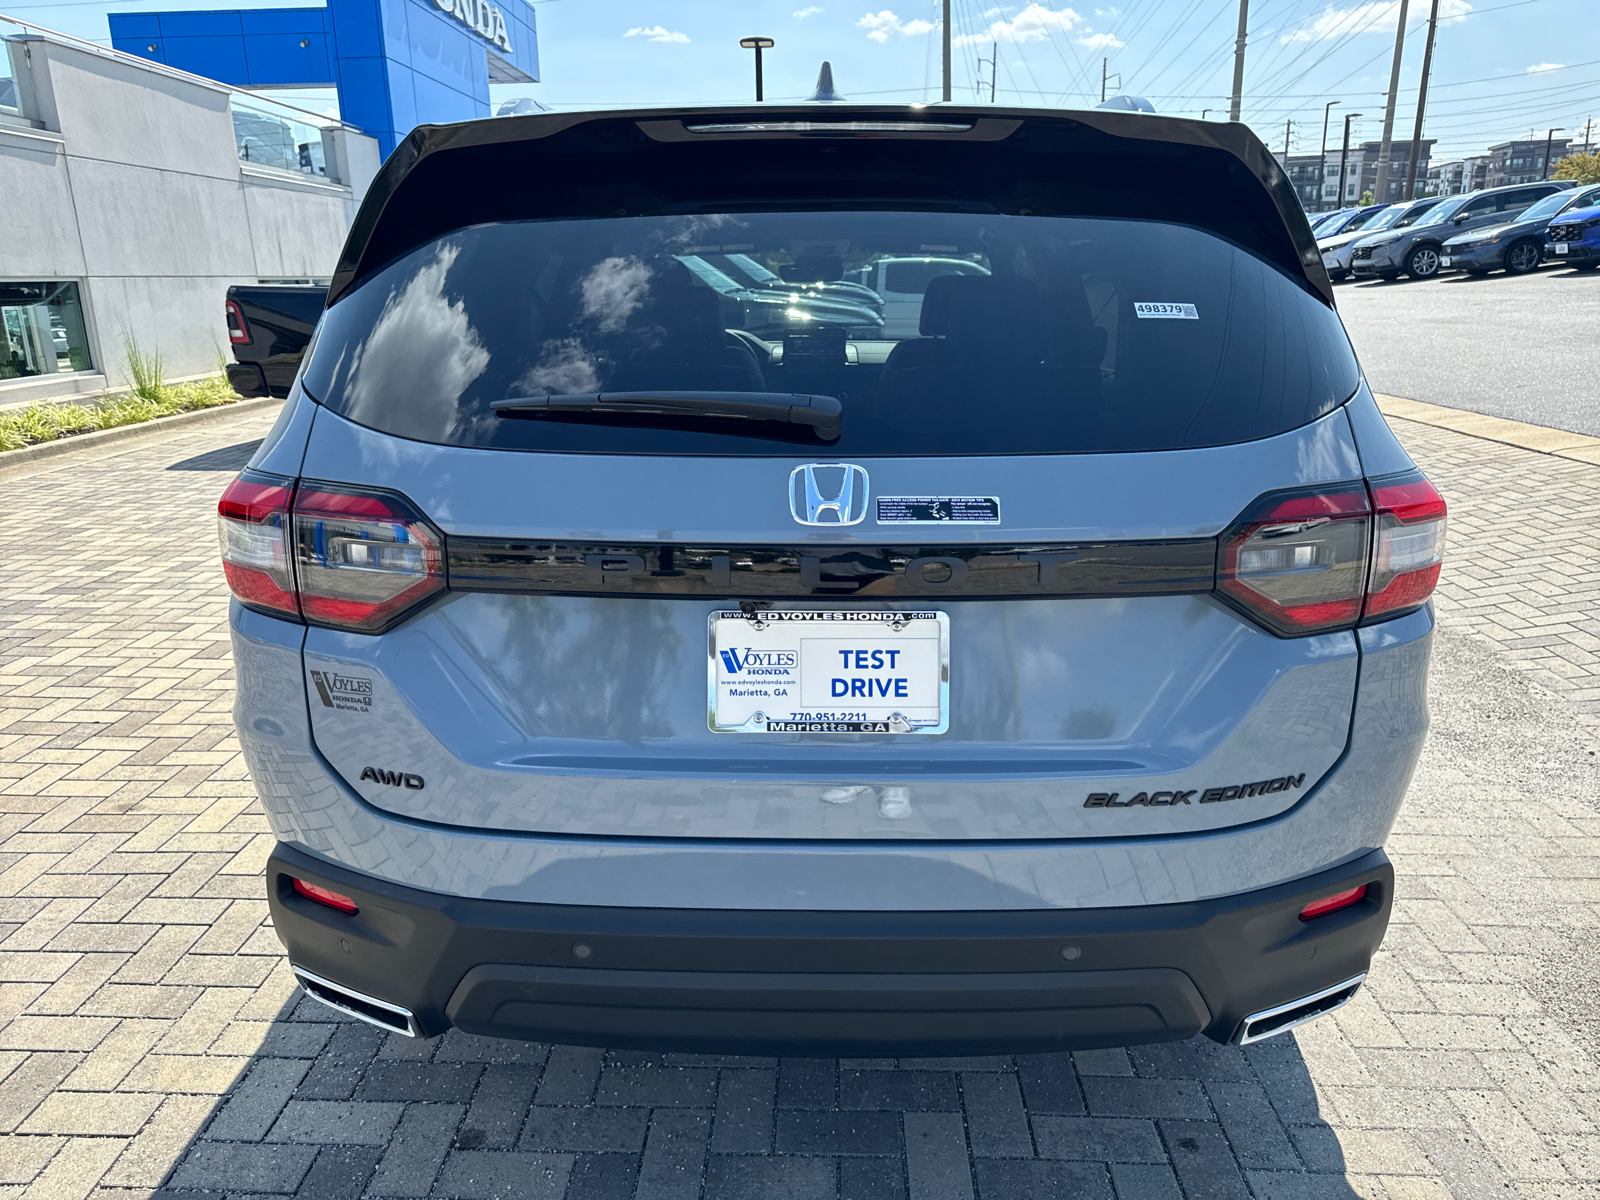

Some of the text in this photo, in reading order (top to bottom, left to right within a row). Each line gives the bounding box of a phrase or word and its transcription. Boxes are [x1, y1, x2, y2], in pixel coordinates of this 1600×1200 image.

[1137, 304, 1182, 313] 498379
[585, 552, 1078, 590] PILOT
[838, 649, 901, 669] TEST
[831, 678, 908, 697] DRIVE
[729, 689, 771, 697] Marietta,
[332, 695, 363, 703] HONDA
[336, 703, 359, 712] Marietta,
[790, 713, 867, 721] 770-951-2211
[770, 722, 887, 732] Marietta, GA
[359, 766, 425, 790] AWD
[1083, 773, 1306, 808] BLACK EDITION
